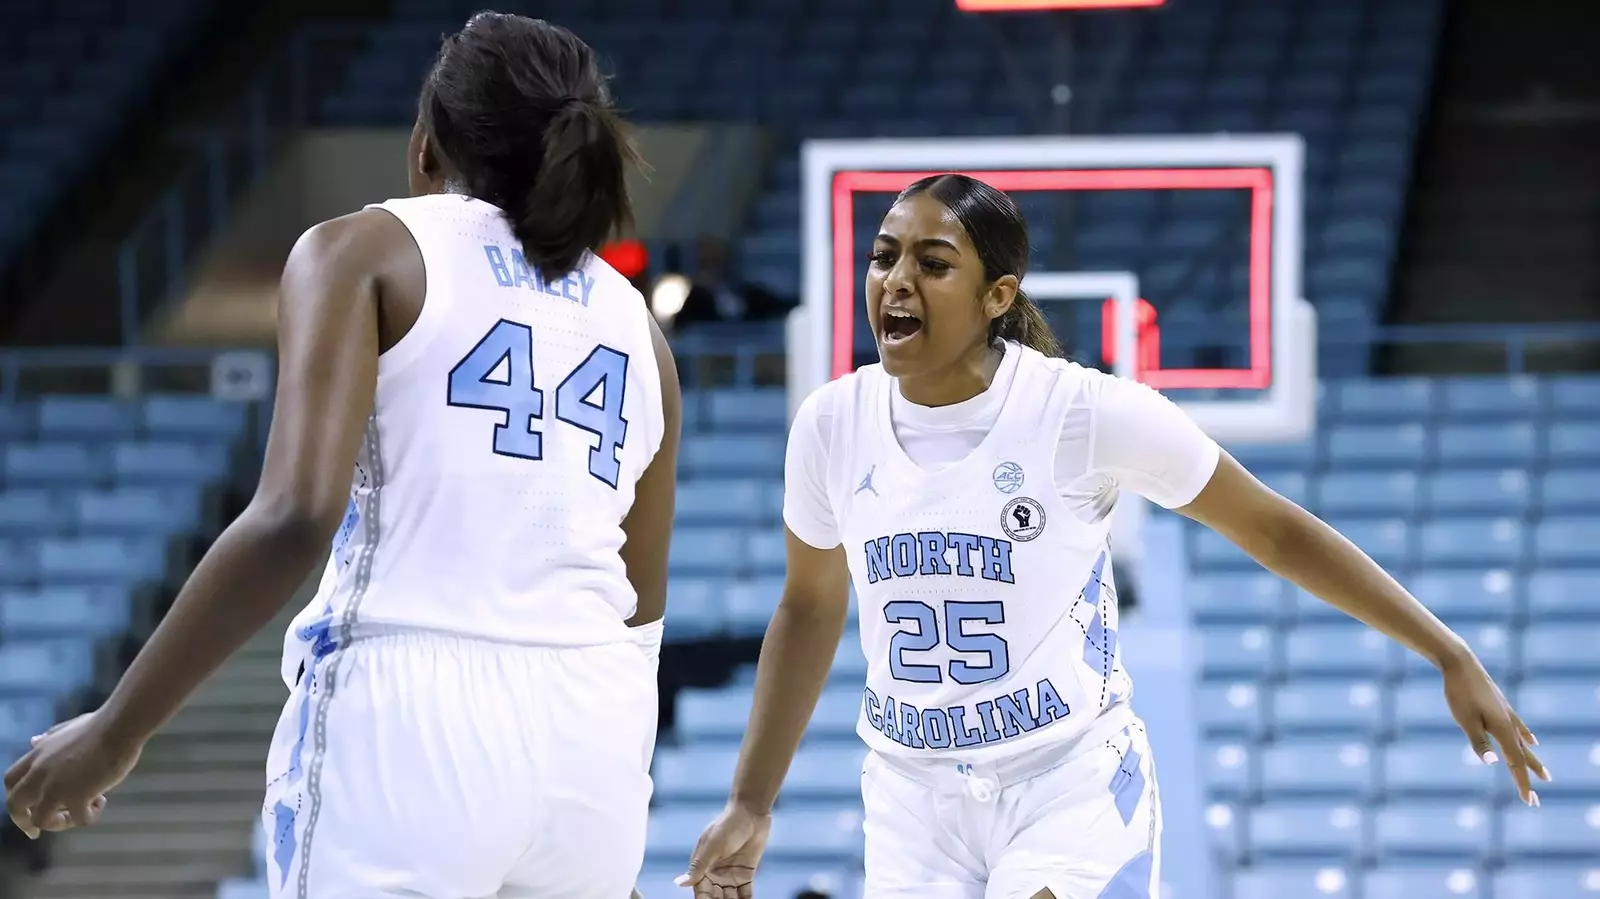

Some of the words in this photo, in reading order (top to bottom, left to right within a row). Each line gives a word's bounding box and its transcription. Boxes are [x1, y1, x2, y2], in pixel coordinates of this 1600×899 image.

[447, 317, 629, 490] 44
[997, 471, 1023, 480] ACC
[864, 531, 1015, 584] NORTH
[883, 600, 1010, 685] 25
[864, 678, 1070, 749] CAROLINA
